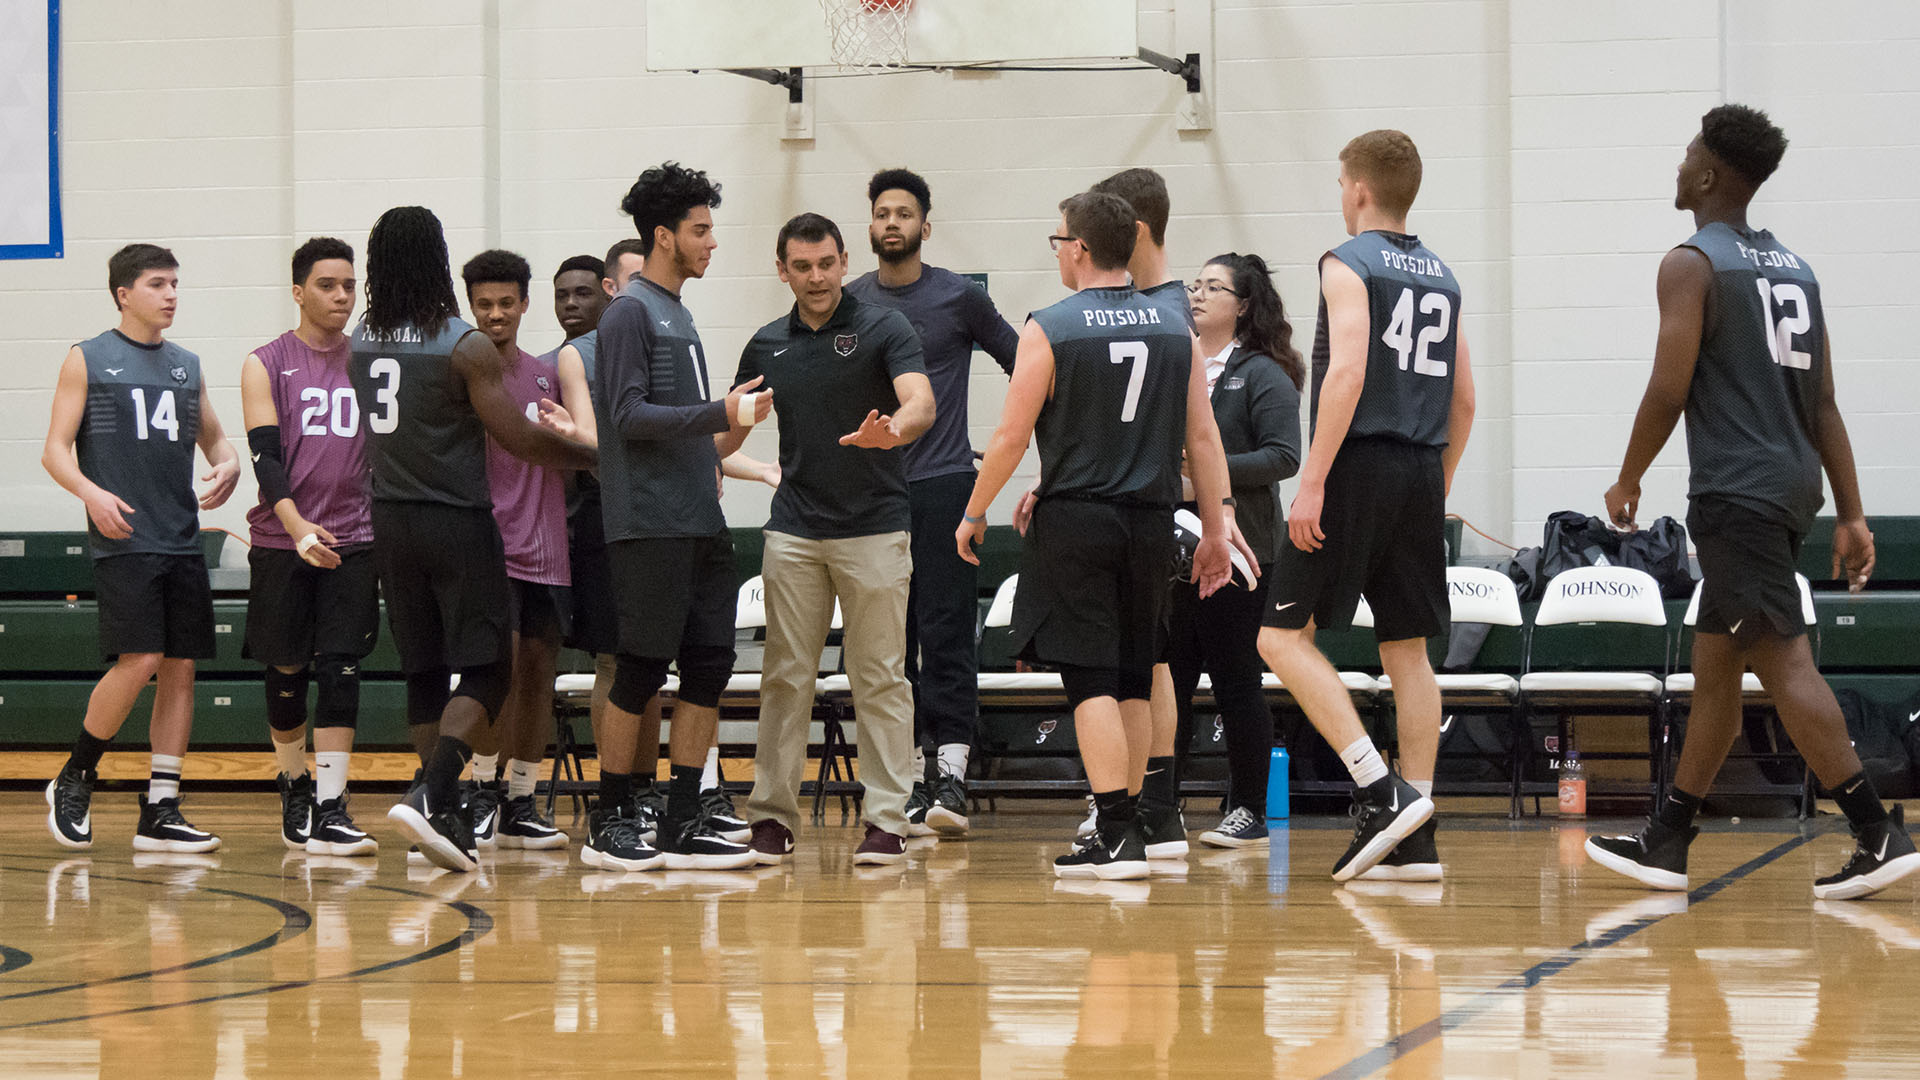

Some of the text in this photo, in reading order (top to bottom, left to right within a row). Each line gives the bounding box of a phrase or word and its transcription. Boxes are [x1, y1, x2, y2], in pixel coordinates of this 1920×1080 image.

[1381, 250, 1444, 277] POTSDAM
[1083, 308, 1160, 327] POTSDAM
[1381, 287, 1451, 377] 42
[1756, 277, 1812, 370] 12
[369, 357, 401, 434] 3
[688, 344, 707, 401] 1
[1108, 340, 1149, 423] 7
[131, 387, 180, 442] 14
[300, 387, 360, 438] 20
[1561, 580, 1644, 598] JOHNSON
[1036, 734, 1047, 744] 3
[1213, 729, 1223, 742] 5
